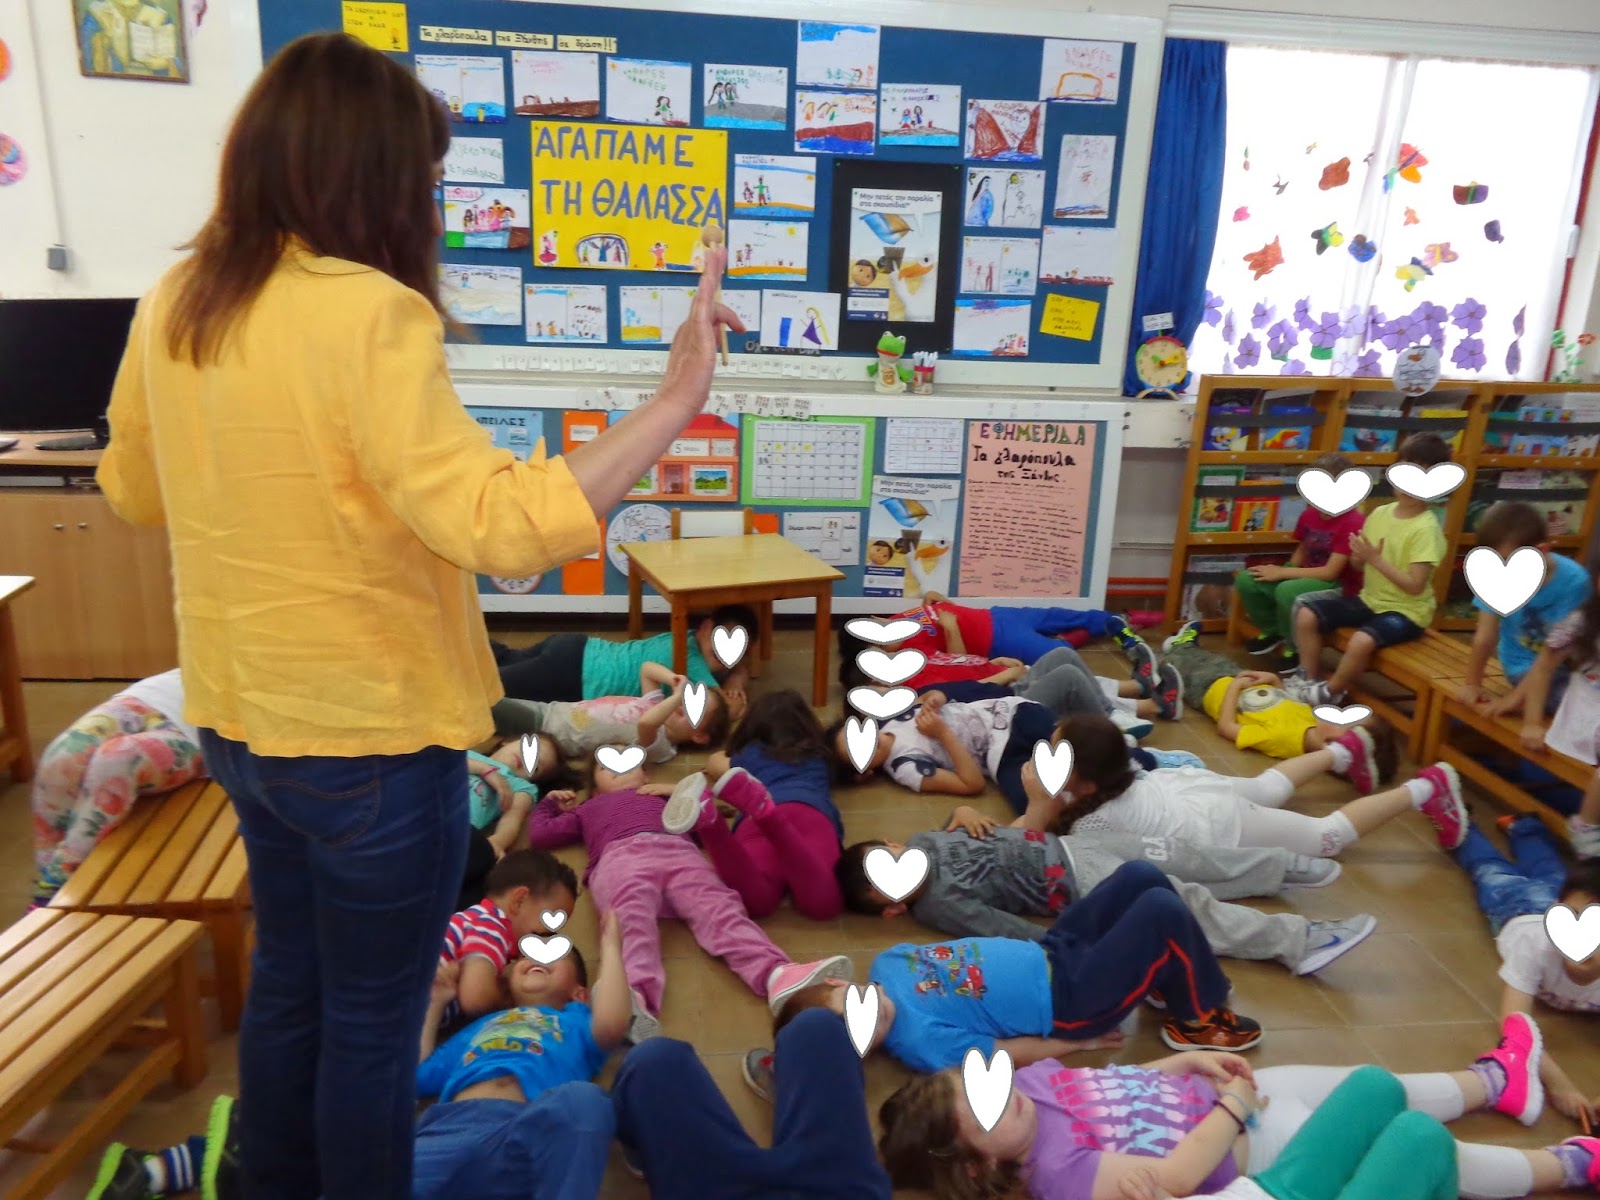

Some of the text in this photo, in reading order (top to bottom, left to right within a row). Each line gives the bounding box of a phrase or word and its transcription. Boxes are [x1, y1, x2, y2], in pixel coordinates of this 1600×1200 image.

[421, 28, 432, 37] Τα
[435, 28, 489, 44] γλαρόπουλα
[535, 125, 694, 168] ΑΓΑΠΑΜΕ
[539, 178, 726, 230] ΤΗ ΘΑΛΑΣΣΑ
[980, 422, 1086, 446] ΕΦΗΜΕΡΙΔΑ
[675, 443, 682, 454] 5
[972, 444, 1076, 468] Τα γλαρόπουλα
